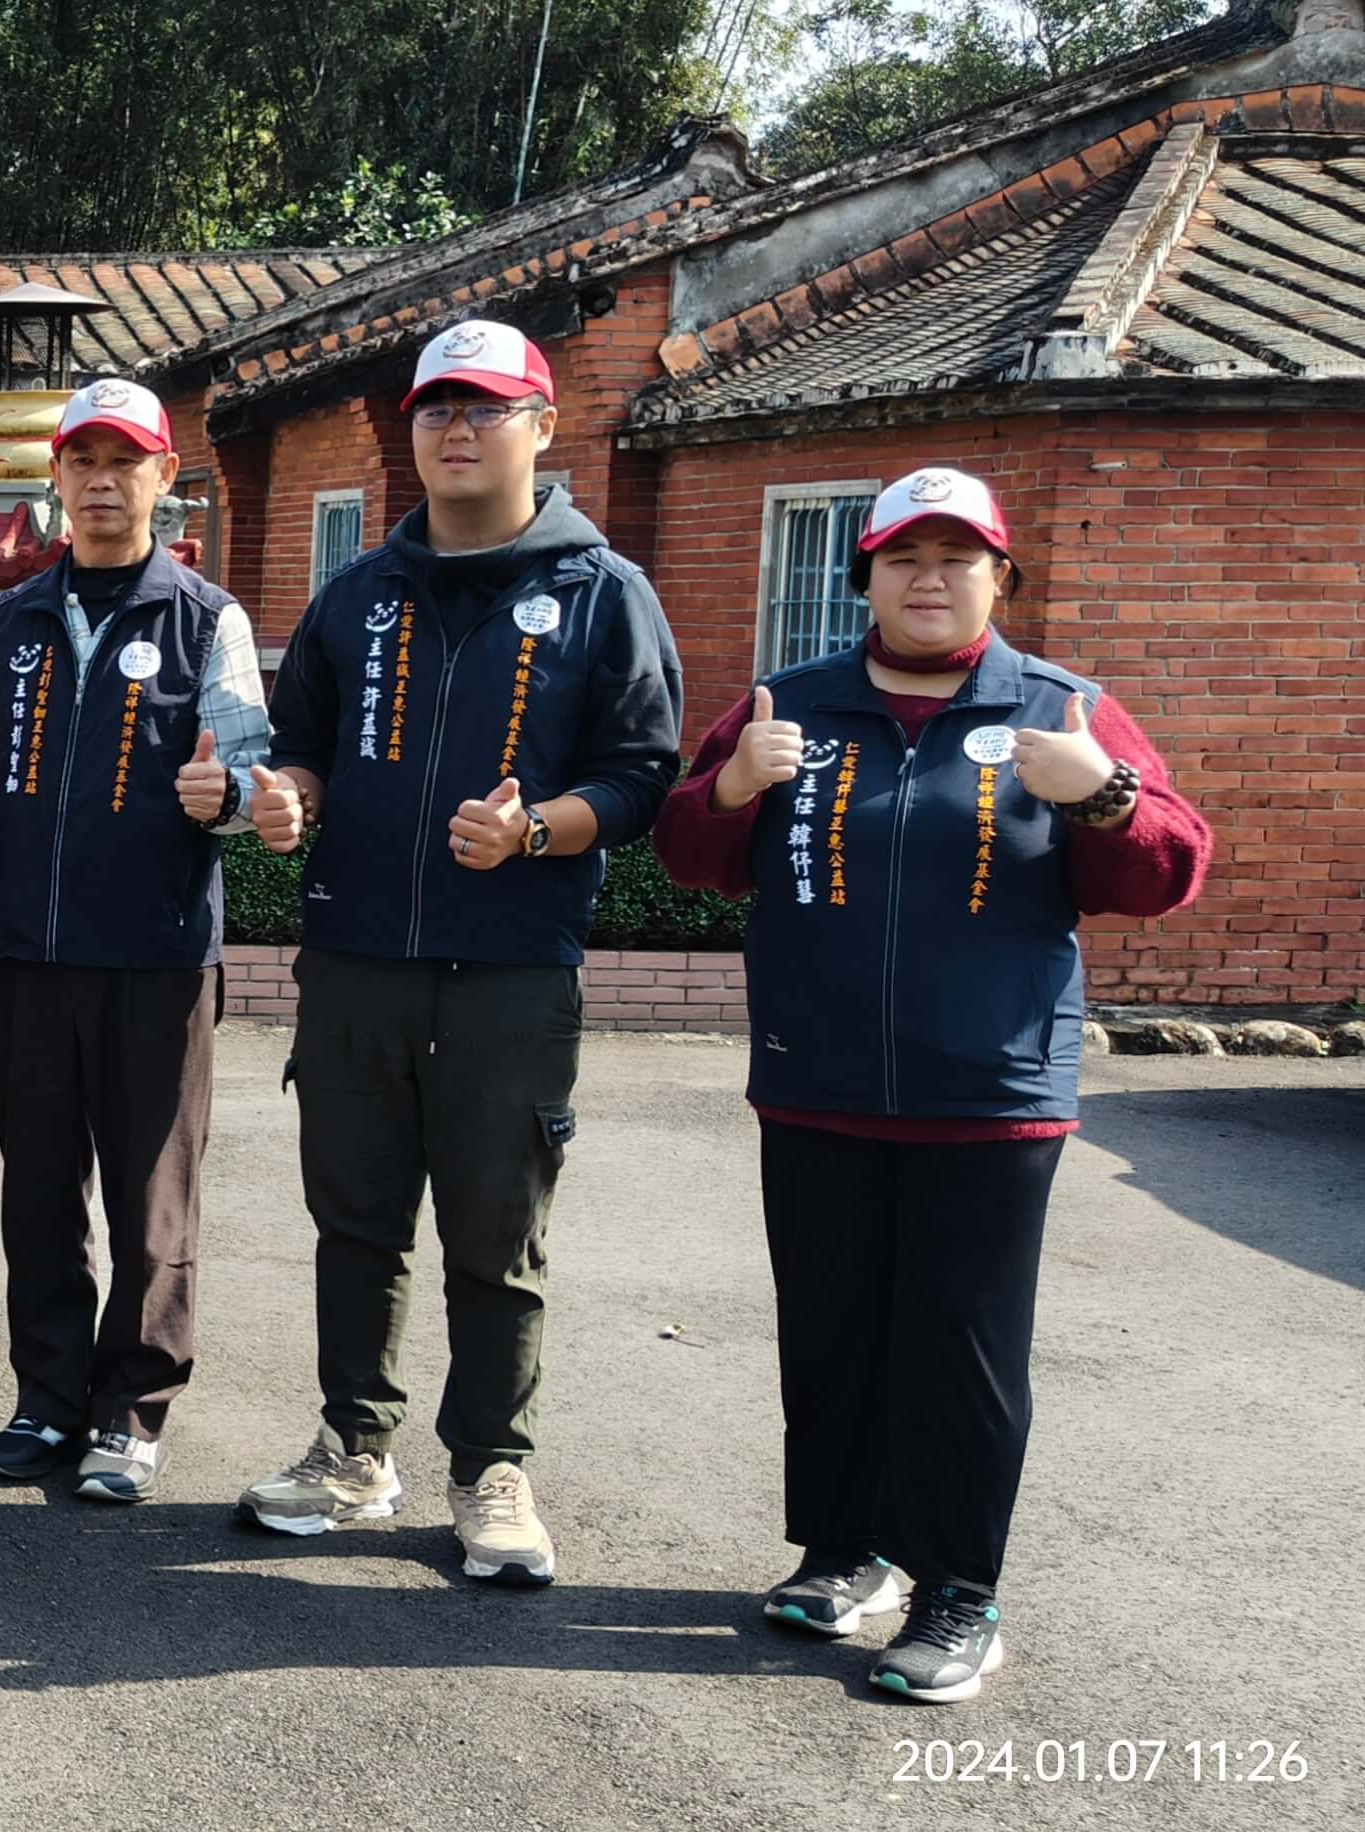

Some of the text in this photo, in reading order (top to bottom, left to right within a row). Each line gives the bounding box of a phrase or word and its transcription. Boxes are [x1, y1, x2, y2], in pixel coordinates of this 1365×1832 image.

[365, 637, 383, 679] 主任
[12, 678, 27, 719] 主任
[794, 774, 819, 815] 主任
